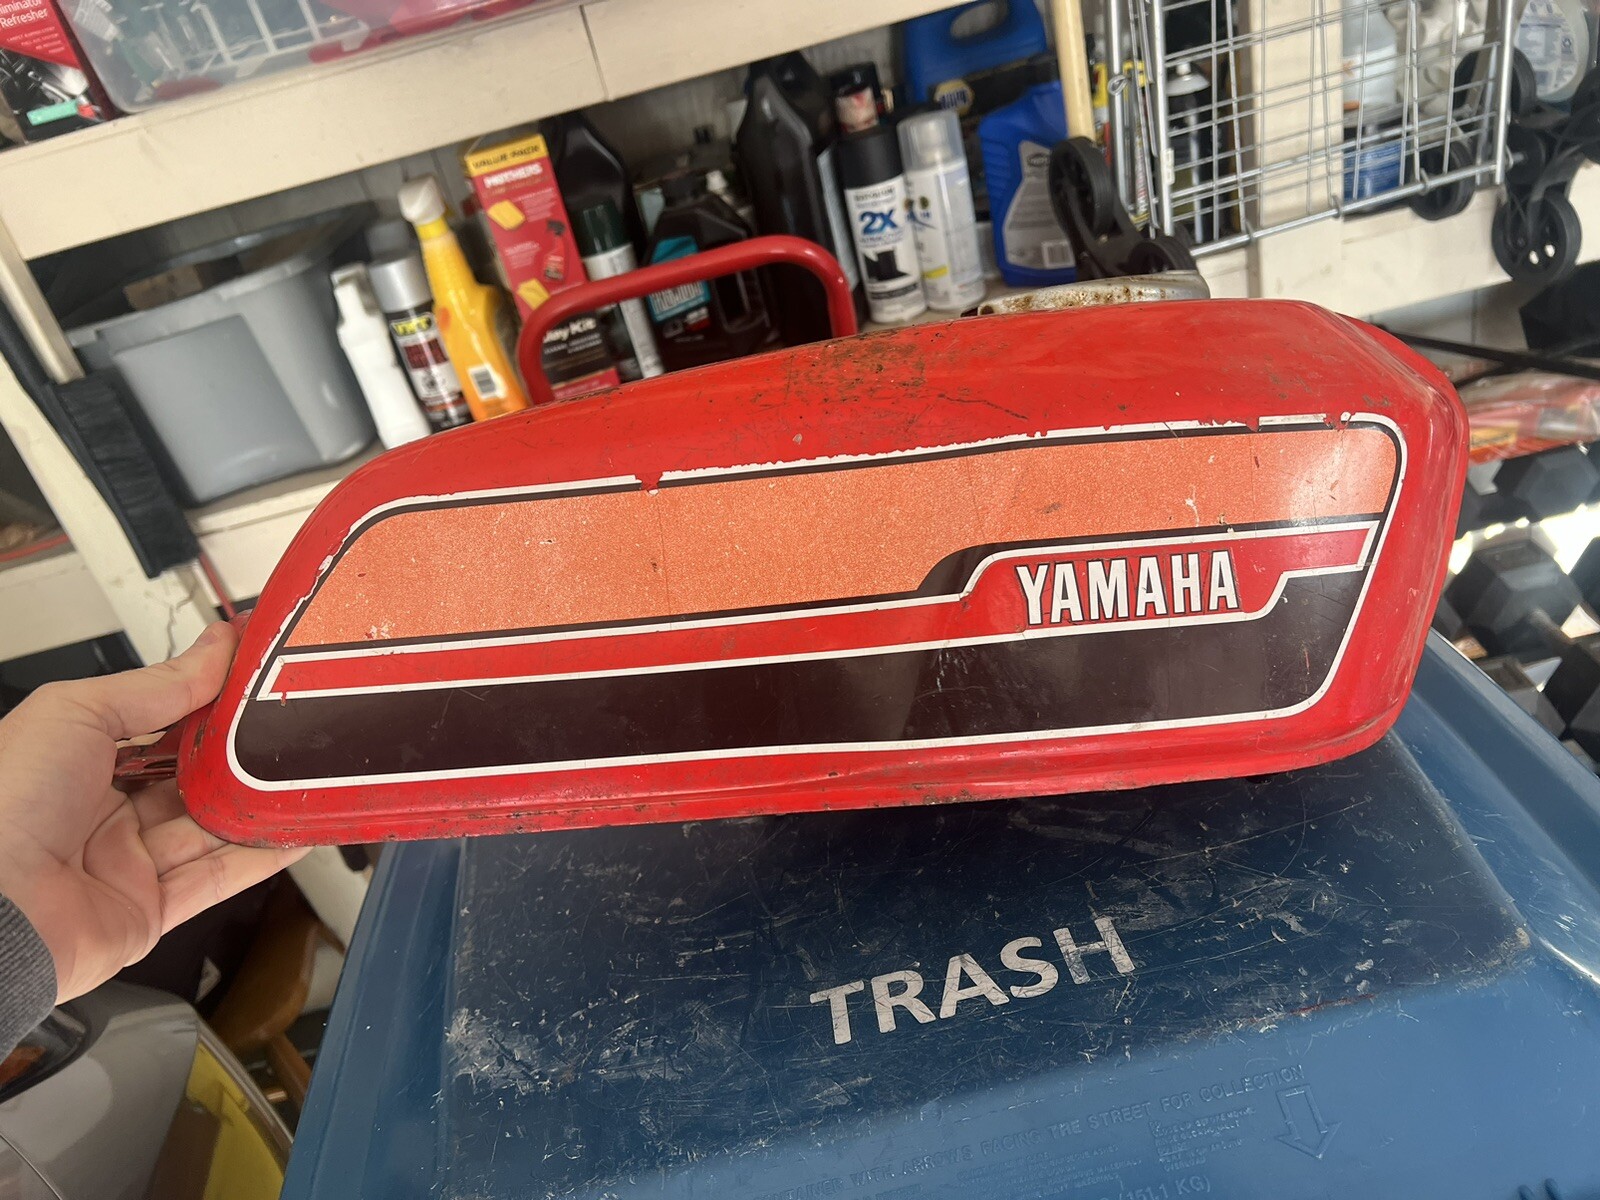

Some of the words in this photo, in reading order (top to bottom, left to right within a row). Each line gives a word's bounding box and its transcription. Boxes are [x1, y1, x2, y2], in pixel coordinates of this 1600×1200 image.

[0, 8, 48, 28] Refresher
[859, 208, 898, 235] 2X
[1014, 549, 1240, 626] YAMAHA
[809, 916, 1136, 1045] TRASH
[901, 1144, 973, 1176] ARROWS
[980, 1128, 1041, 1157] FACING
[1046, 1118, 1081, 1142] THE
[1087, 1101, 1152, 1131] STREET
[1159, 1091, 1195, 1114] FOR
[1199, 1064, 1306, 1103] COLLECTION
[1175, 1175, 1211, 1195] KG)
